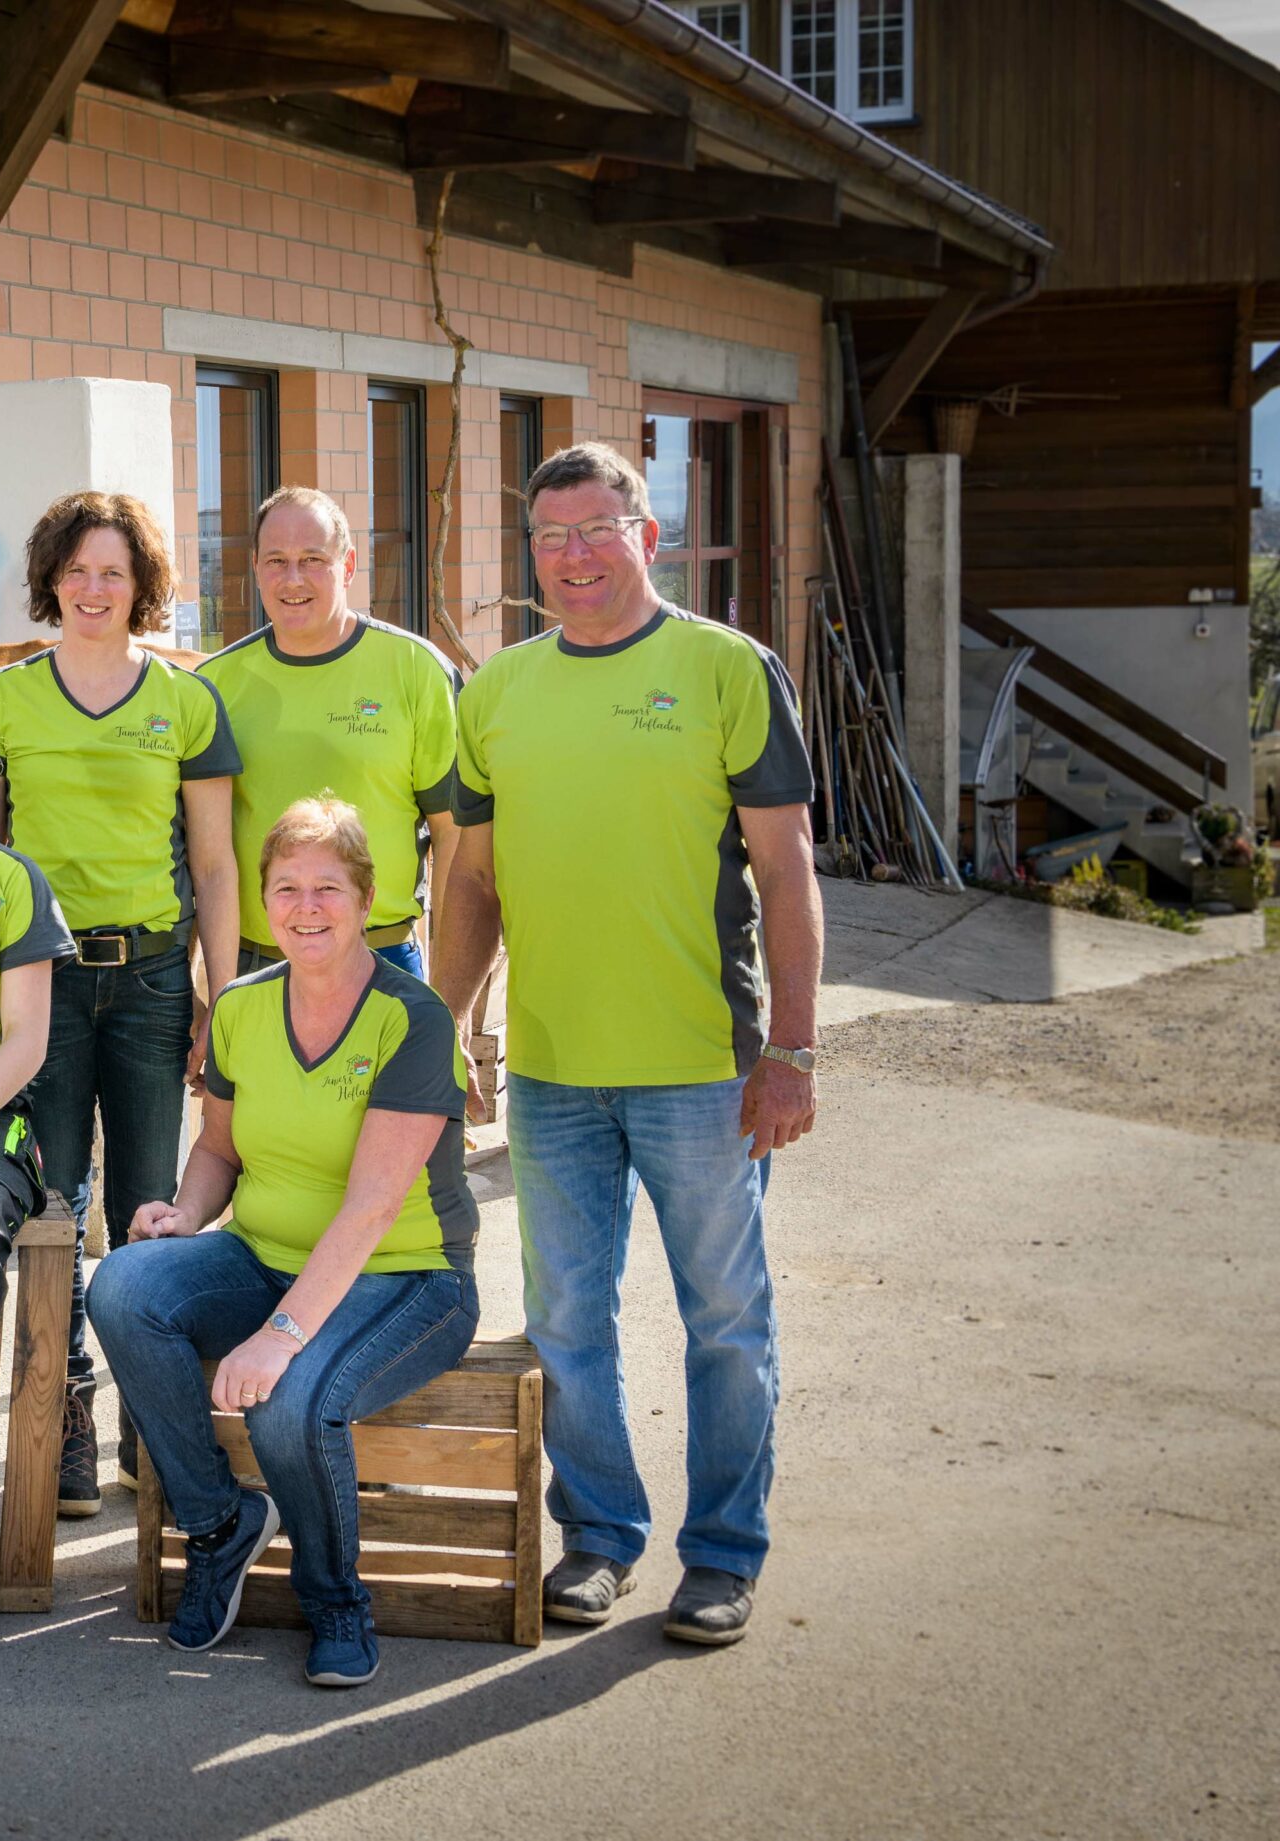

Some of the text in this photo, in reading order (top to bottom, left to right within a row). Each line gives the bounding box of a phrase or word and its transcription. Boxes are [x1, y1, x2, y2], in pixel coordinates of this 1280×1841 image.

[611, 704, 650, 717] Tanners
[326, 712, 360, 724] Tanners
[347, 722, 388, 735] Hofladen
[631, 716, 682, 734] Hofladen
[114, 726, 150, 738] Tanners
[138, 738, 176, 753] Hofladen
